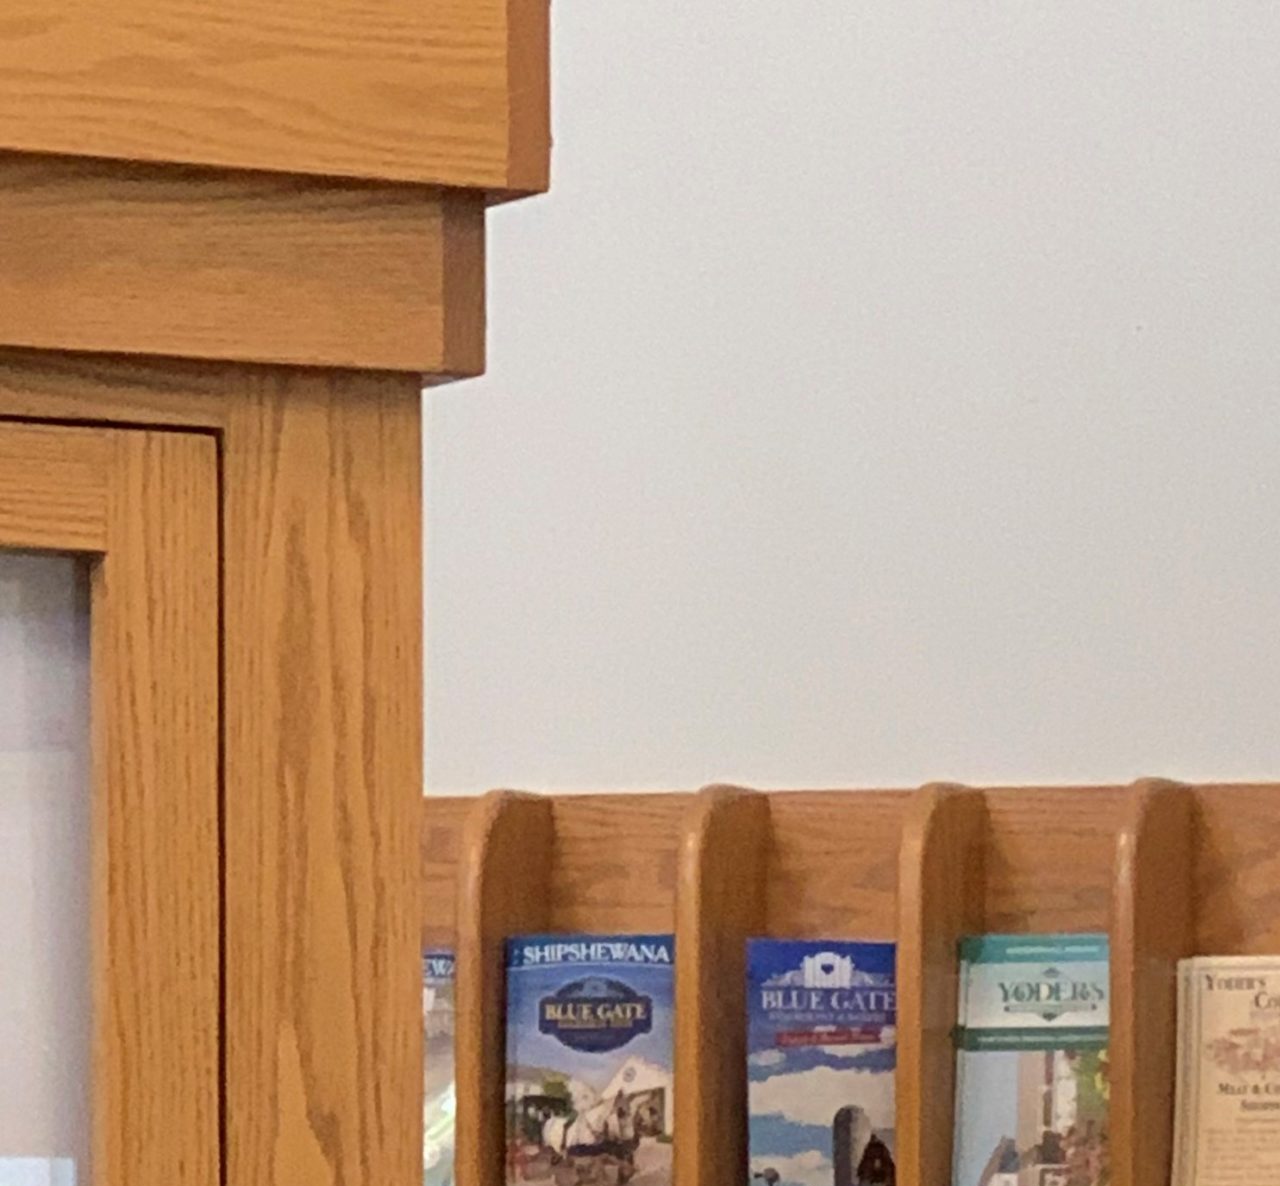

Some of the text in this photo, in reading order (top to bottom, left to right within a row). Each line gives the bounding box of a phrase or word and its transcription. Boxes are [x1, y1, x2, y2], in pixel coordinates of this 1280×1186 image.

[523, 942, 670, 964] SHIPSHEWANA
[761, 989, 896, 1011] BLUE GATE
[544, 1002, 647, 1021] BLUE GATE
